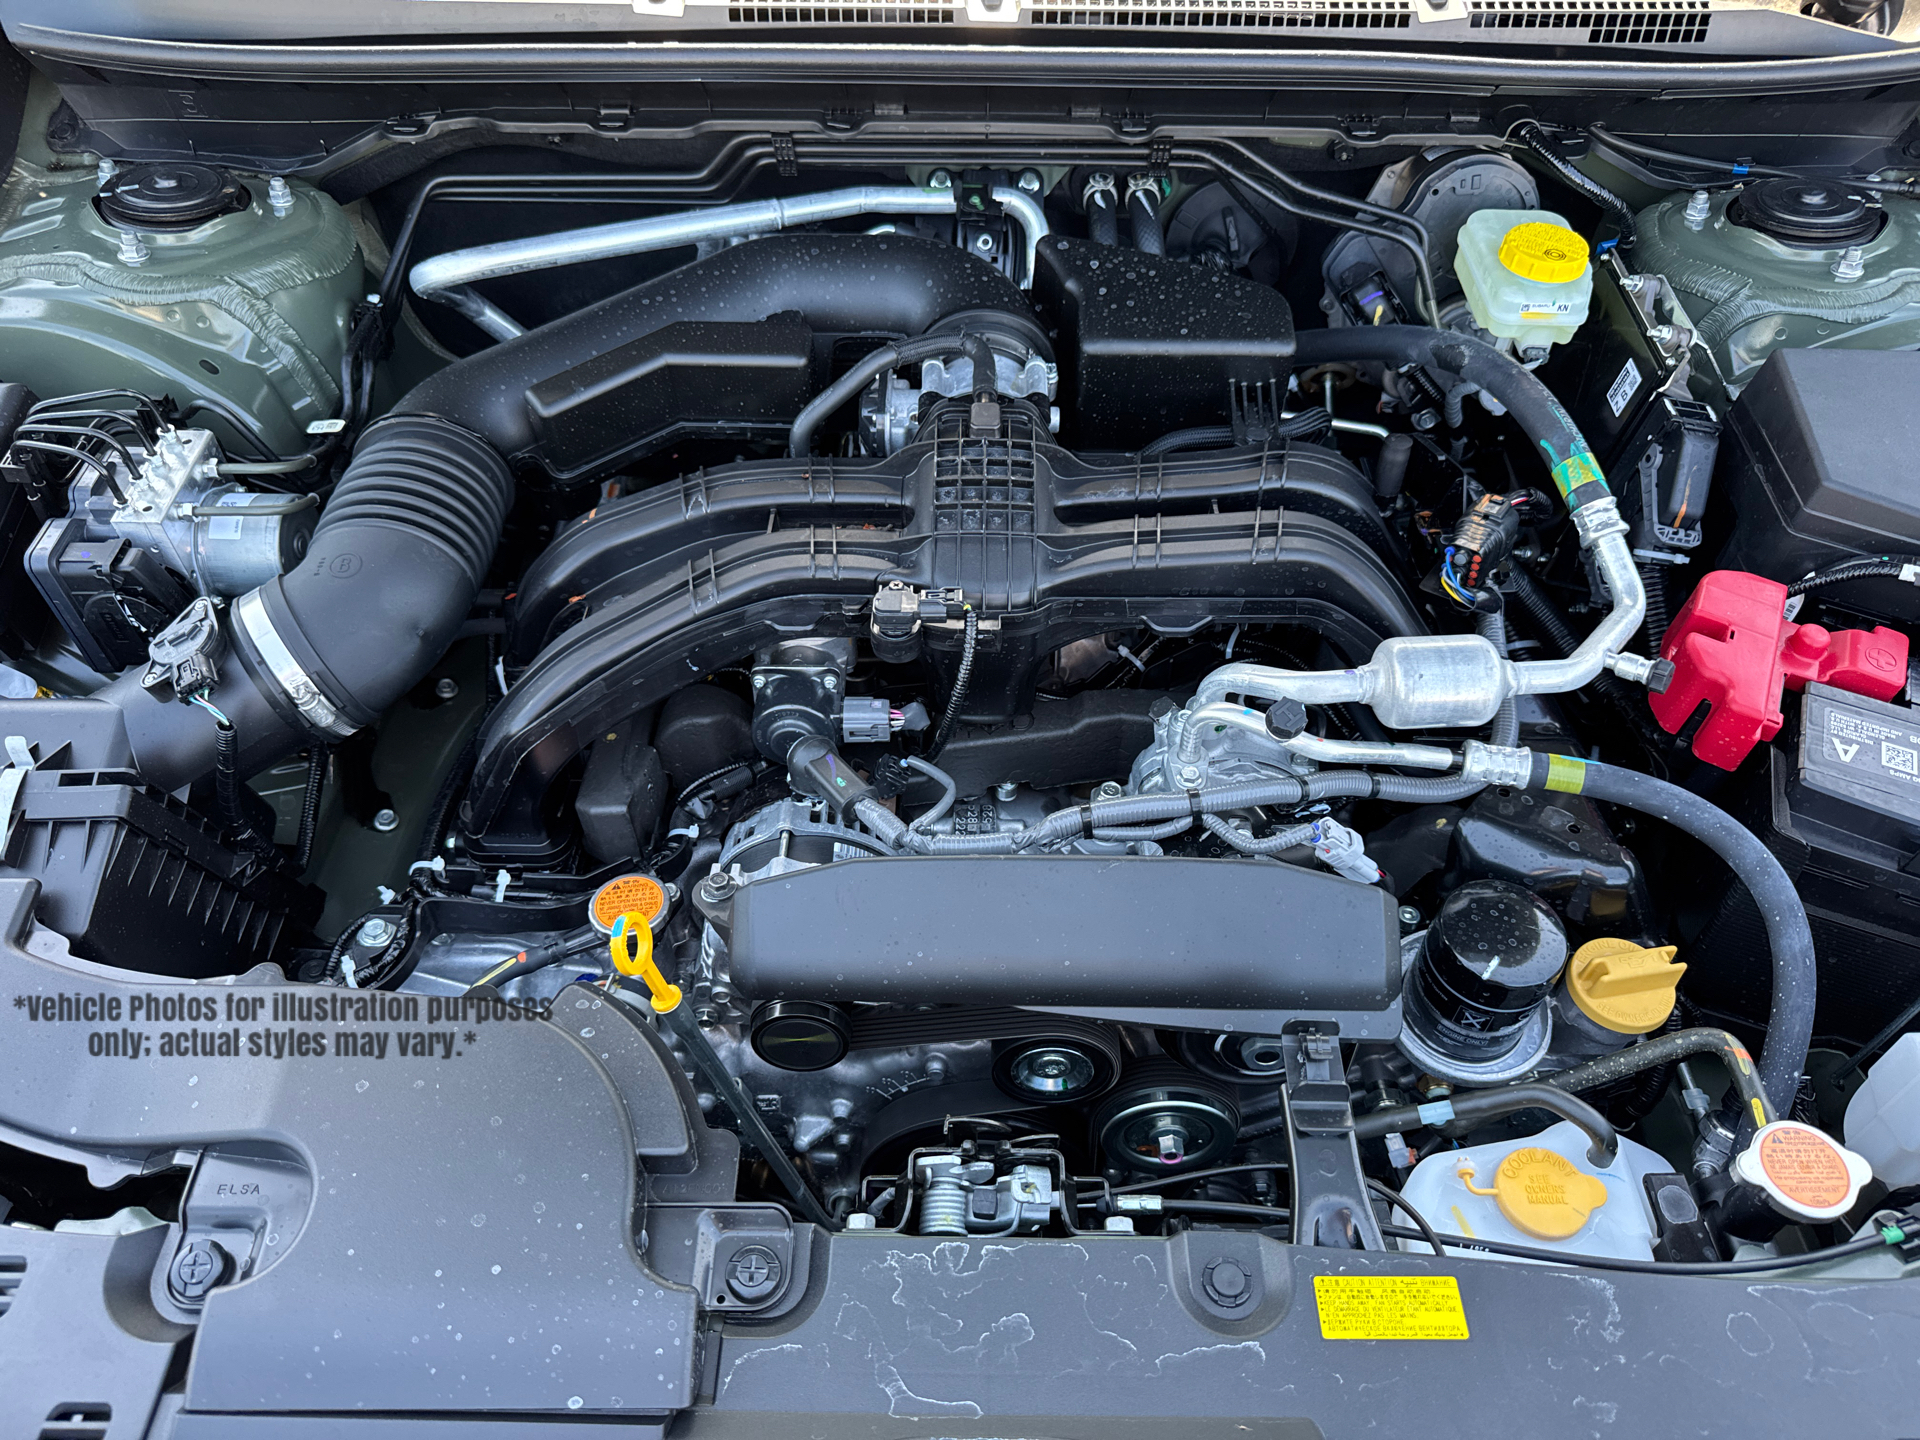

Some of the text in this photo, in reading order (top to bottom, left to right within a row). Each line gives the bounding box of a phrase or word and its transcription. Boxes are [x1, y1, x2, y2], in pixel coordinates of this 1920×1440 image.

[1557, 304, 1569, 312] KN
[1830, 712, 1861, 725] MATERIALS
[1862, 721, 1890, 733] IMPORTED
[1838, 731, 1874, 746] DISTRIBUTED
[1881, 731, 1896, 739] MADE
[1831, 737, 1860, 763] A
[1889, 769, 1912, 781] AMPS
[1577, 939, 1617, 965] ENGINE
[1596, 1002, 1614, 1016] SEE
[1502, 1150, 1579, 1179] COOLANT
[1528, 1174, 1550, 1184] SEE
[217, 1184, 260, 1195] ELSA
[1525, 1184, 1566, 1194] OWNERS
[1526, 1195, 1569, 1205] MANUAL
[1368, 1278, 1398, 1286] ATTENTION
[1420, 1279, 1452, 1287] ВНИМАНИЕ
